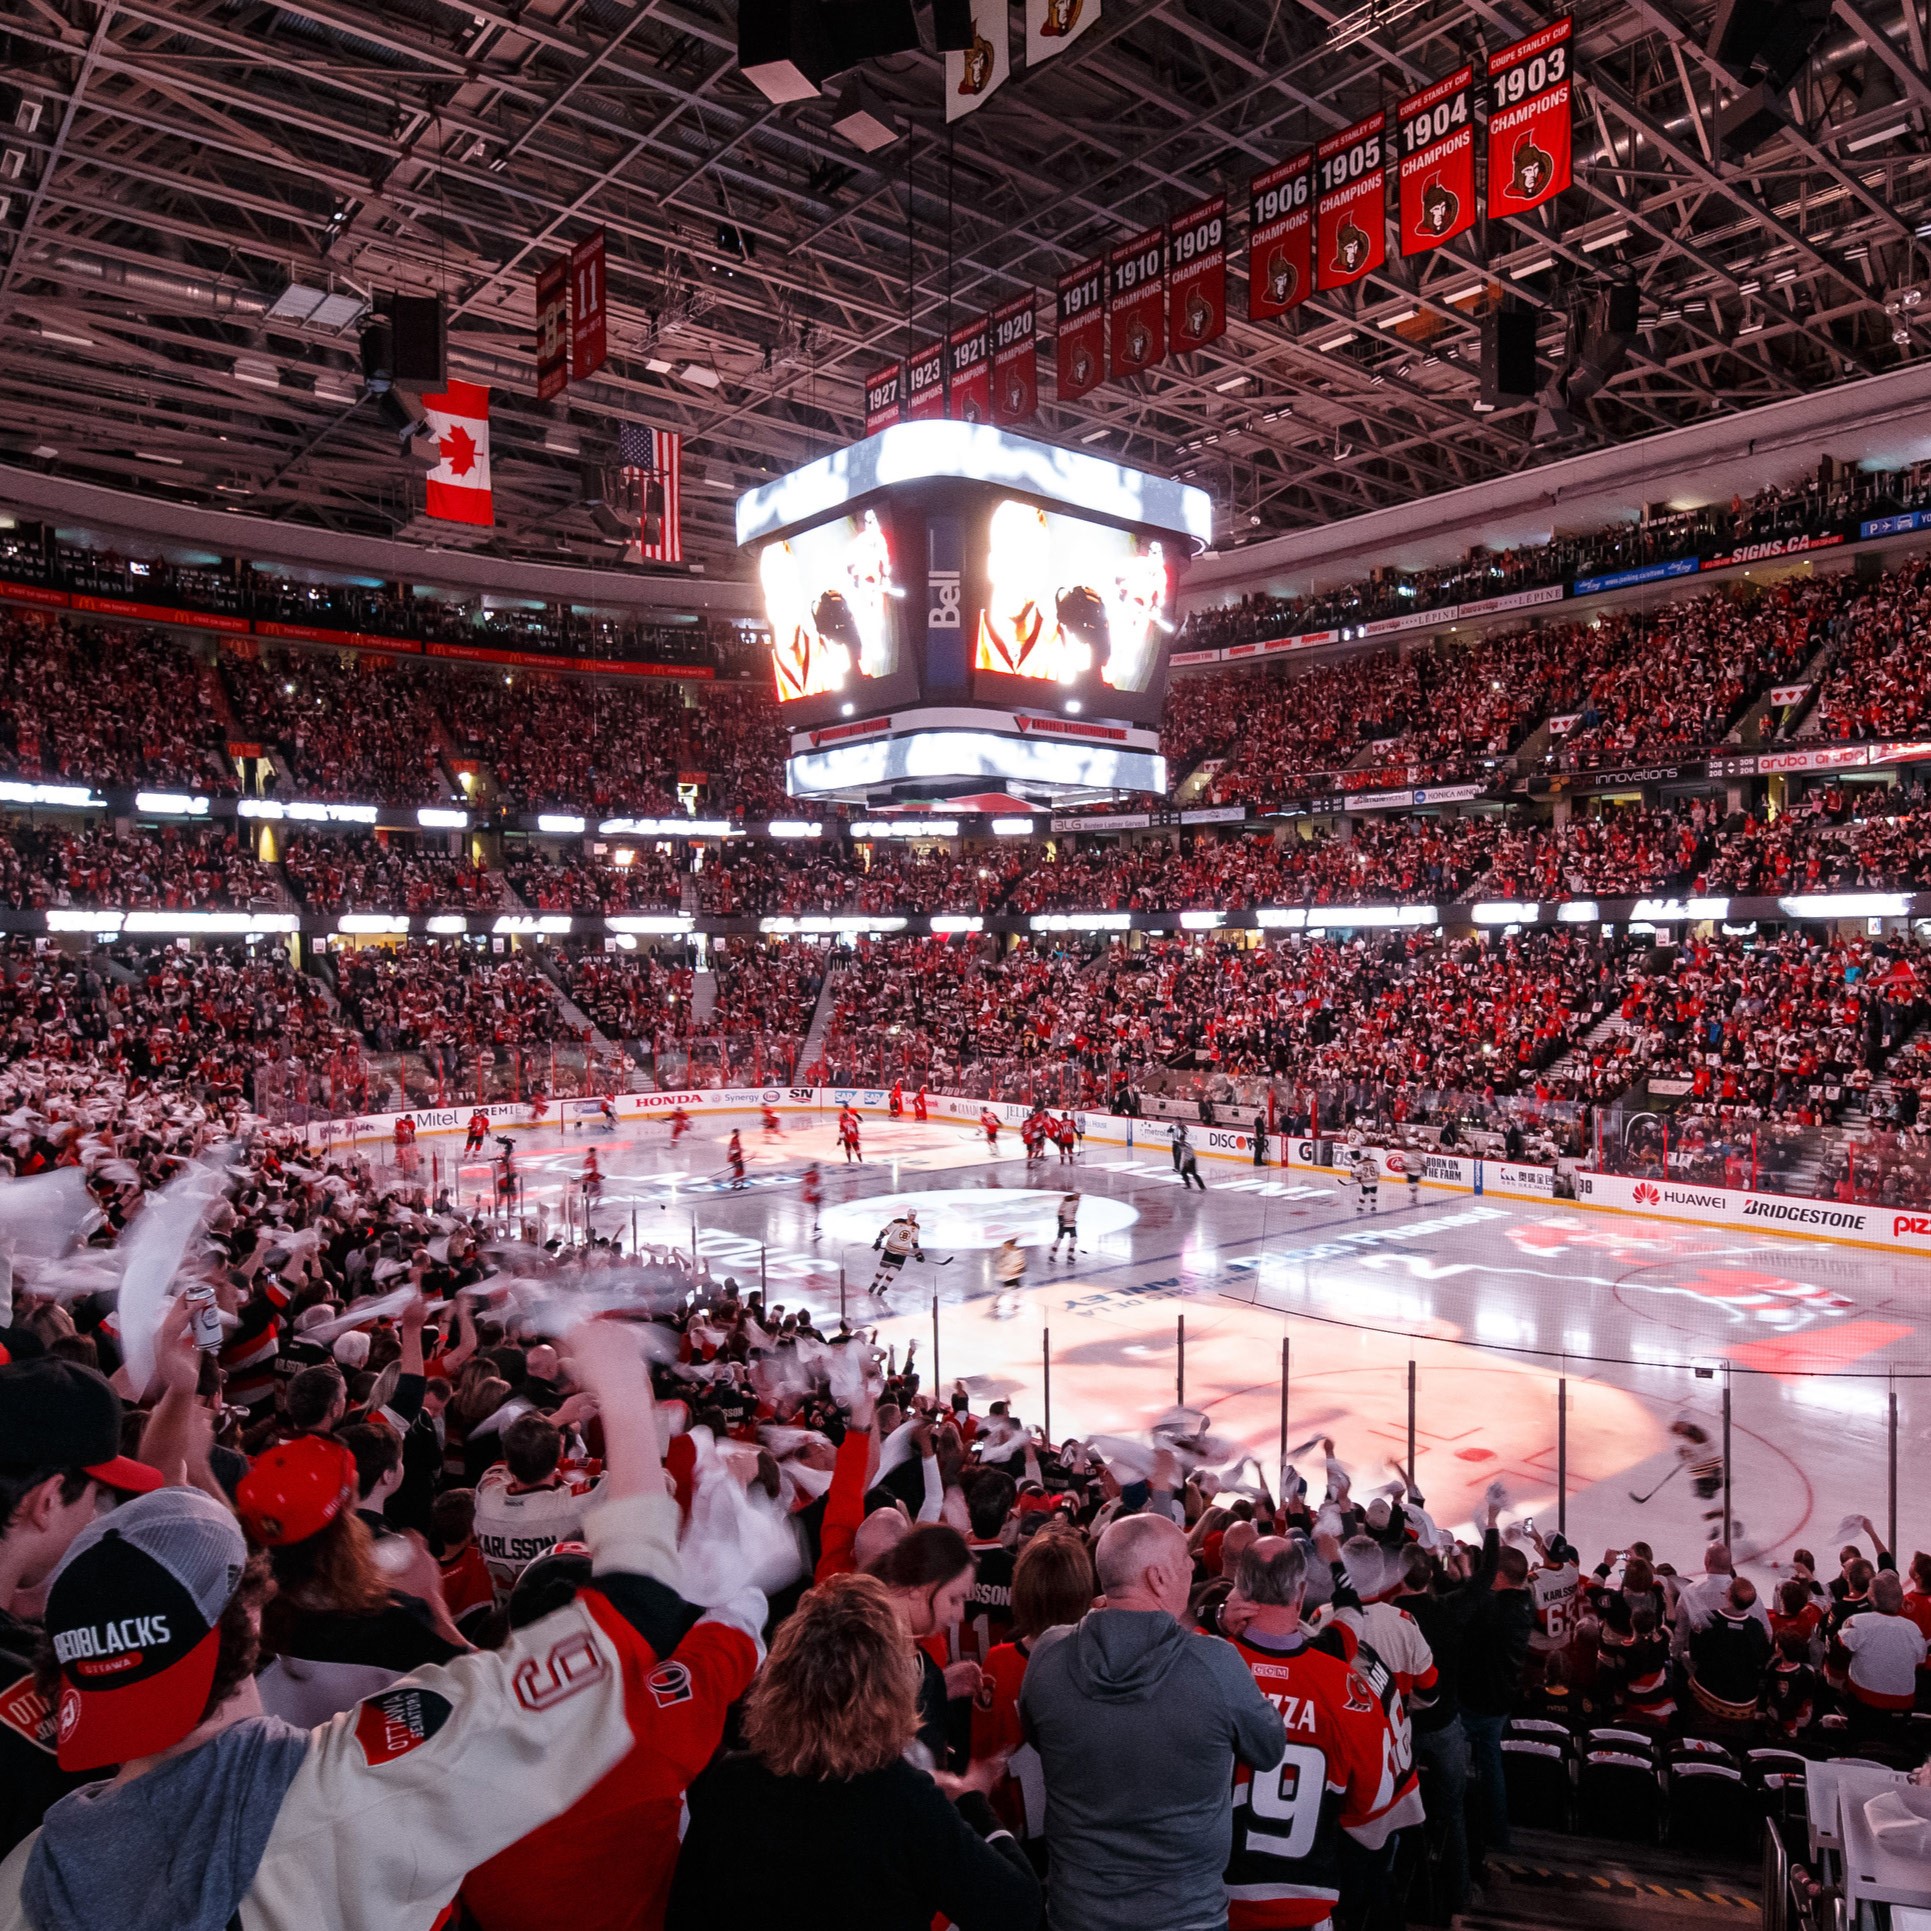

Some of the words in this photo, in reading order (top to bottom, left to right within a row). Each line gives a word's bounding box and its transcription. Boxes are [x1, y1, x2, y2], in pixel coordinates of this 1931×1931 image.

[1491, 52, 1516, 70] COUPE
[1517, 36, 1551, 58] STANLEY
[1552, 23, 1569, 39] CUP
[1400, 97, 1422, 116] COUPE
[1423, 81, 1453, 104] STANLEY
[1454, 71, 1470, 86] CUP
[1493, 47, 1566, 108] 1903
[1403, 92, 1468, 151] 1904
[1490, 86, 1568, 135] CHAMPIONS
[1340, 126, 1368, 145] STANLEY
[1368, 116, 1383, 130] CUP
[1321, 136, 1380, 190] 1905
[1401, 130, 1470, 177] CHAMPIONS
[1255, 175, 1308, 224] 1906
[1319, 173, 1382, 215] CHAMPIONS
[1174, 218, 1222, 262] 1909
[1252, 210, 1308, 247] CHAMPIONS
[1115, 249, 1159, 290] 1910
[1172, 251, 1223, 285] CHAMPIONS
[578, 260, 598, 321] 11
[1063, 277, 1098, 315] 1911
[1112, 280, 1162, 312] CHAMPIONS
[997, 310, 1033, 346] 1920
[1058, 306, 1102, 337] CHAMPIONS
[953, 334, 985, 369] 1921
[995, 338, 1034, 366] CHAMPIONS
[910, 357, 940, 391] 1923
[952, 362, 988, 388] CHAMPIONS
[868, 379, 897, 411] 1927
[867, 405, 898, 428] CHAMPIONS
[1731, 534, 1810, 563] SIGNS.CA
[928, 571, 961, 628] Bell
[1518, 587, 1561, 605] LÉPINE
[1418, 609, 1457, 625] LÉPINE
[1595, 767, 1678, 785] innovations
[1760, 754, 1808, 770] aruba
[1428, 790, 1455, 800] KONICA
[635, 1094, 703, 1108] HONDA
[725, 1093, 760, 1104] Synergy
[788, 1088, 814, 1099] SN
[417, 1109, 459, 1128] Mitel
[1005, 1105, 1030, 1120] JELD
[1209, 1132, 1270, 1153] DISCOVR
[1426, 1157, 1447, 1168] BORN
[1448, 1160, 1459, 1170] ON
[1439, 1169, 1462, 1181] FARM
[1664, 1190, 1727, 1209] HUAWEI
[1742, 1198, 1867, 1231] BRIDGESTONE
[723, 1406, 744, 1418] SSON
[480, 1534, 558, 1560] ARLSSON
[974, 1583, 1012, 1606] SSON
[84, 1658, 131, 1674] OTTAWA
[1252, 1664, 1290, 1679] CCM
[8, 1690, 51, 1726] OTT
[382, 1694, 409, 1752] OTTAWA
[404, 1691, 425, 1739] SENATORS
[1268, 1693, 1316, 1733] ZZA
